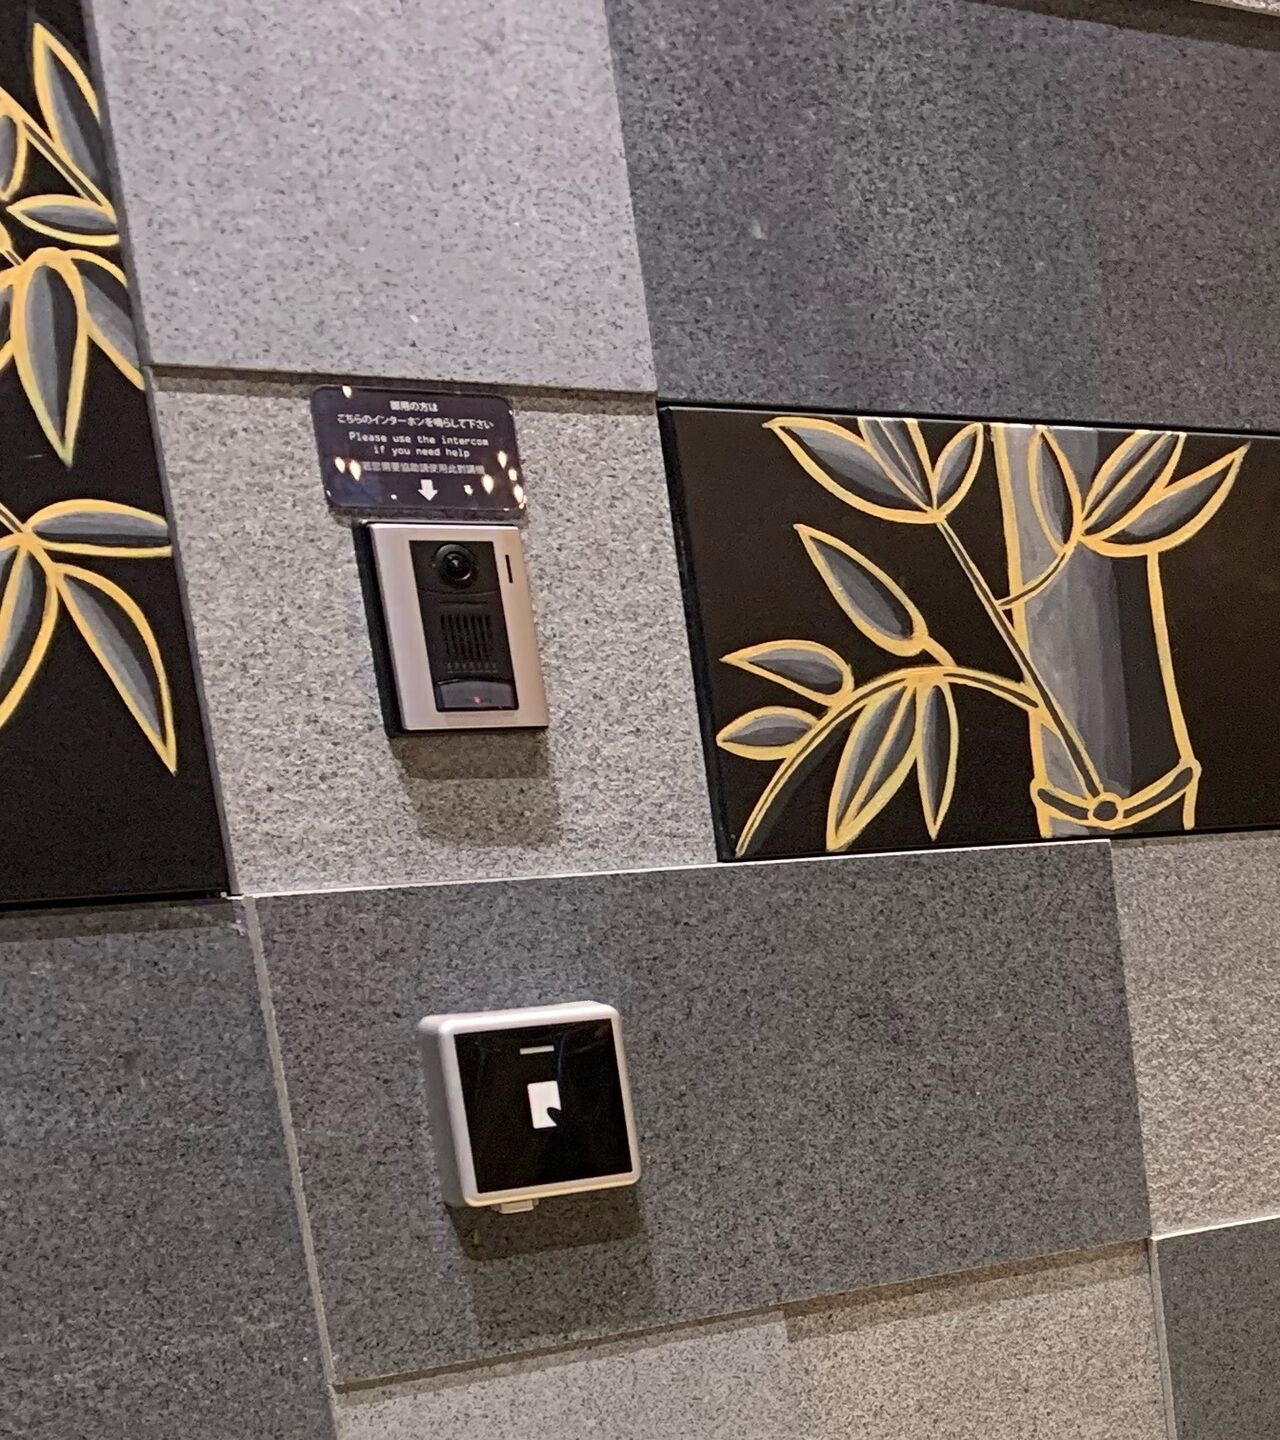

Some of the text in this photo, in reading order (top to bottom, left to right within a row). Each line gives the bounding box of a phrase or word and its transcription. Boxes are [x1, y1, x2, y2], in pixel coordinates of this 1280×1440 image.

[349, 431, 490, 447] Please use the intercom
[373, 445, 471, 458] if you need help
